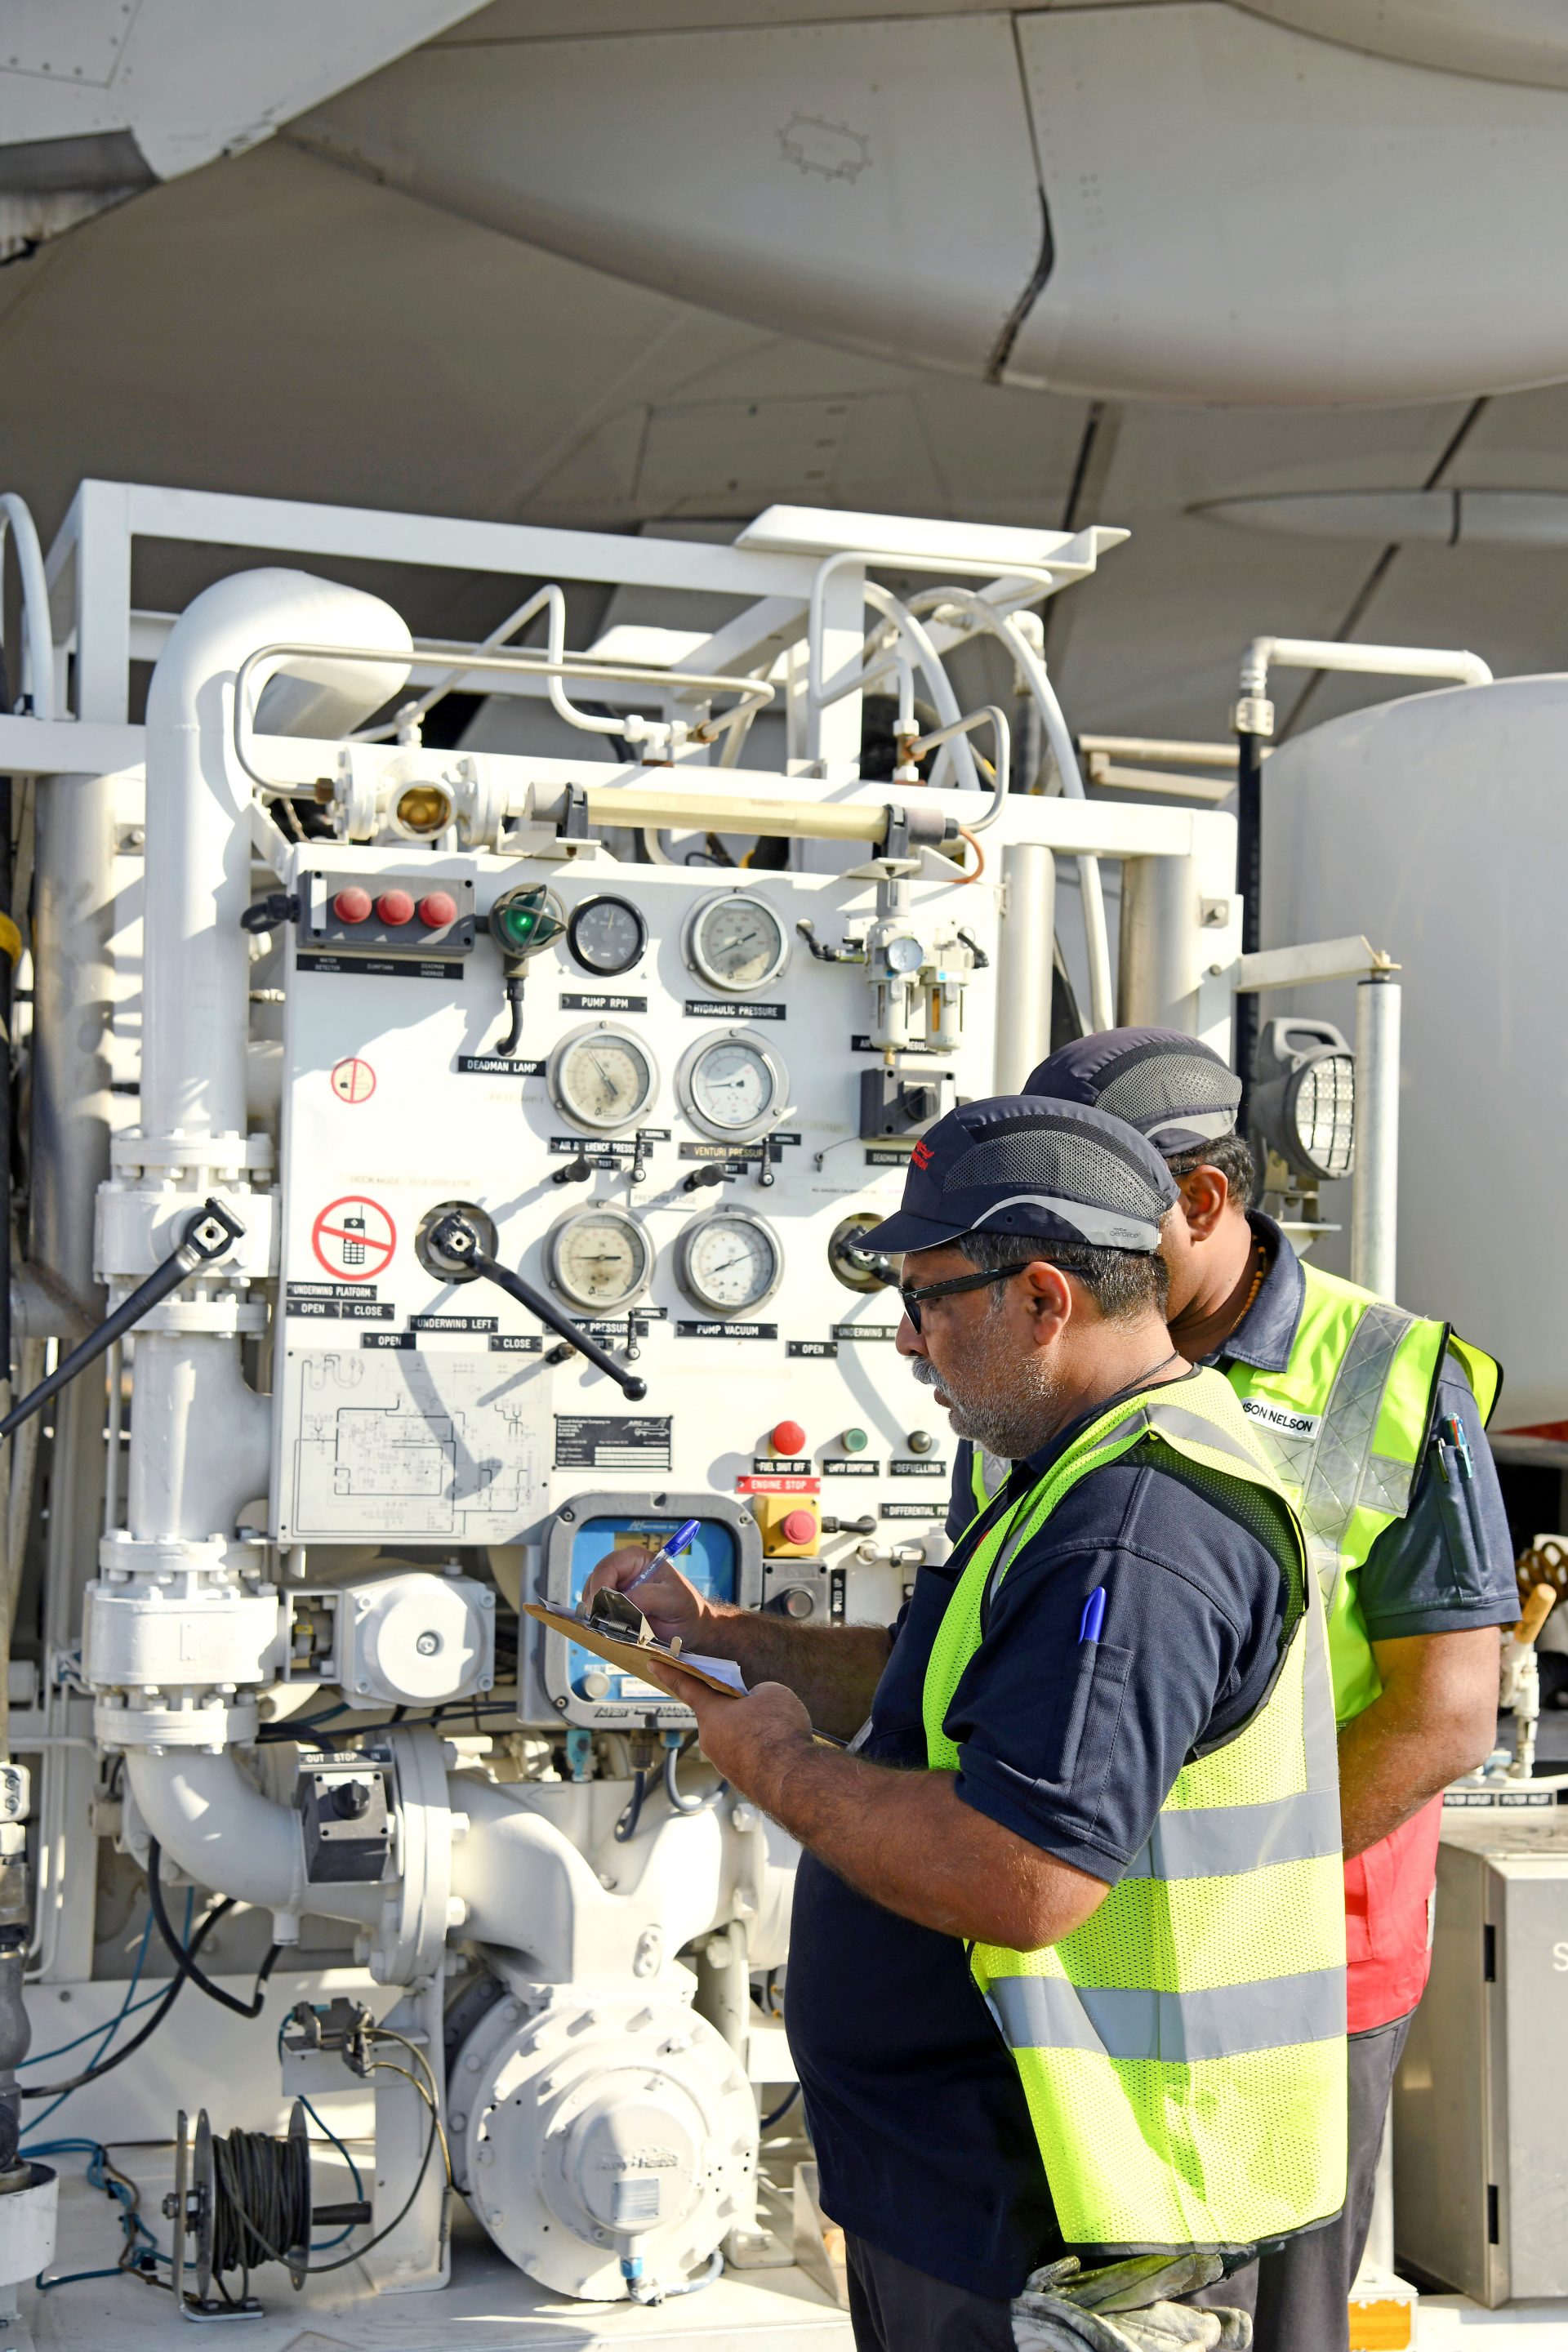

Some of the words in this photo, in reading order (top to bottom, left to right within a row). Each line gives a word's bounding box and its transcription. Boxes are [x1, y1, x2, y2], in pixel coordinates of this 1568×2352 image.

[581, 997, 606, 1007] PUMP
[610, 998, 629, 1009] RPM
[693, 1004, 735, 1015] HYDRAULIC
[739, 1006, 777, 1017] PRESSURE
[467, 1060, 509, 1072] DEADMAN
[513, 1062, 537, 1073] LAMP
[559, 1141, 571, 1151] AIR
[573, 1142, 610, 1152] RERENCE
[694, 1147, 726, 1157] VENTURI
[728, 1148, 764, 1158] PRESSUR
[873, 1152, 898, 1163] DEADMAN
[294, 1287, 333, 1296] UNDERWING
[336, 1289, 371, 1298] PLATFORM
[301, 1303, 325, 1313] OPEN
[354, 1305, 382, 1316] CLOSE
[416, 1317, 467, 1329] UNDERWING
[471, 1320, 492, 1330] LEFT
[590, 1323, 629, 1334] PRESSUR
[697, 1325, 721, 1334] PUMP
[724, 1325, 760, 1336] VACUUM
[839, 1327, 883, 1338] UNDERWING
[378, 1336, 403, 1347] OPEN
[503, 1338, 532, 1348] CLOSE
[802, 1343, 825, 1354] OPEN
[1268, 1410, 1313, 1432] NELSON
[760, 1463, 775, 1472] FUEL
[777, 1463, 792, 1472] SHUT
[794, 1463, 806, 1472] OFF
[896, 1464, 941, 1474] DEFUELLING
[751, 1480, 782, 1490] ENGINE
[786, 1481, 807, 1490] STOP
[889, 1506, 934, 1517] DIFFERENTIAL
[834, 1577, 843, 1588] UP
[833, 1590, 843, 1612] SPEED
[306, 1753, 324, 1762] OUT
[333, 1752, 357, 1762] STOP
[371, 1752, 381, 1760] IN
